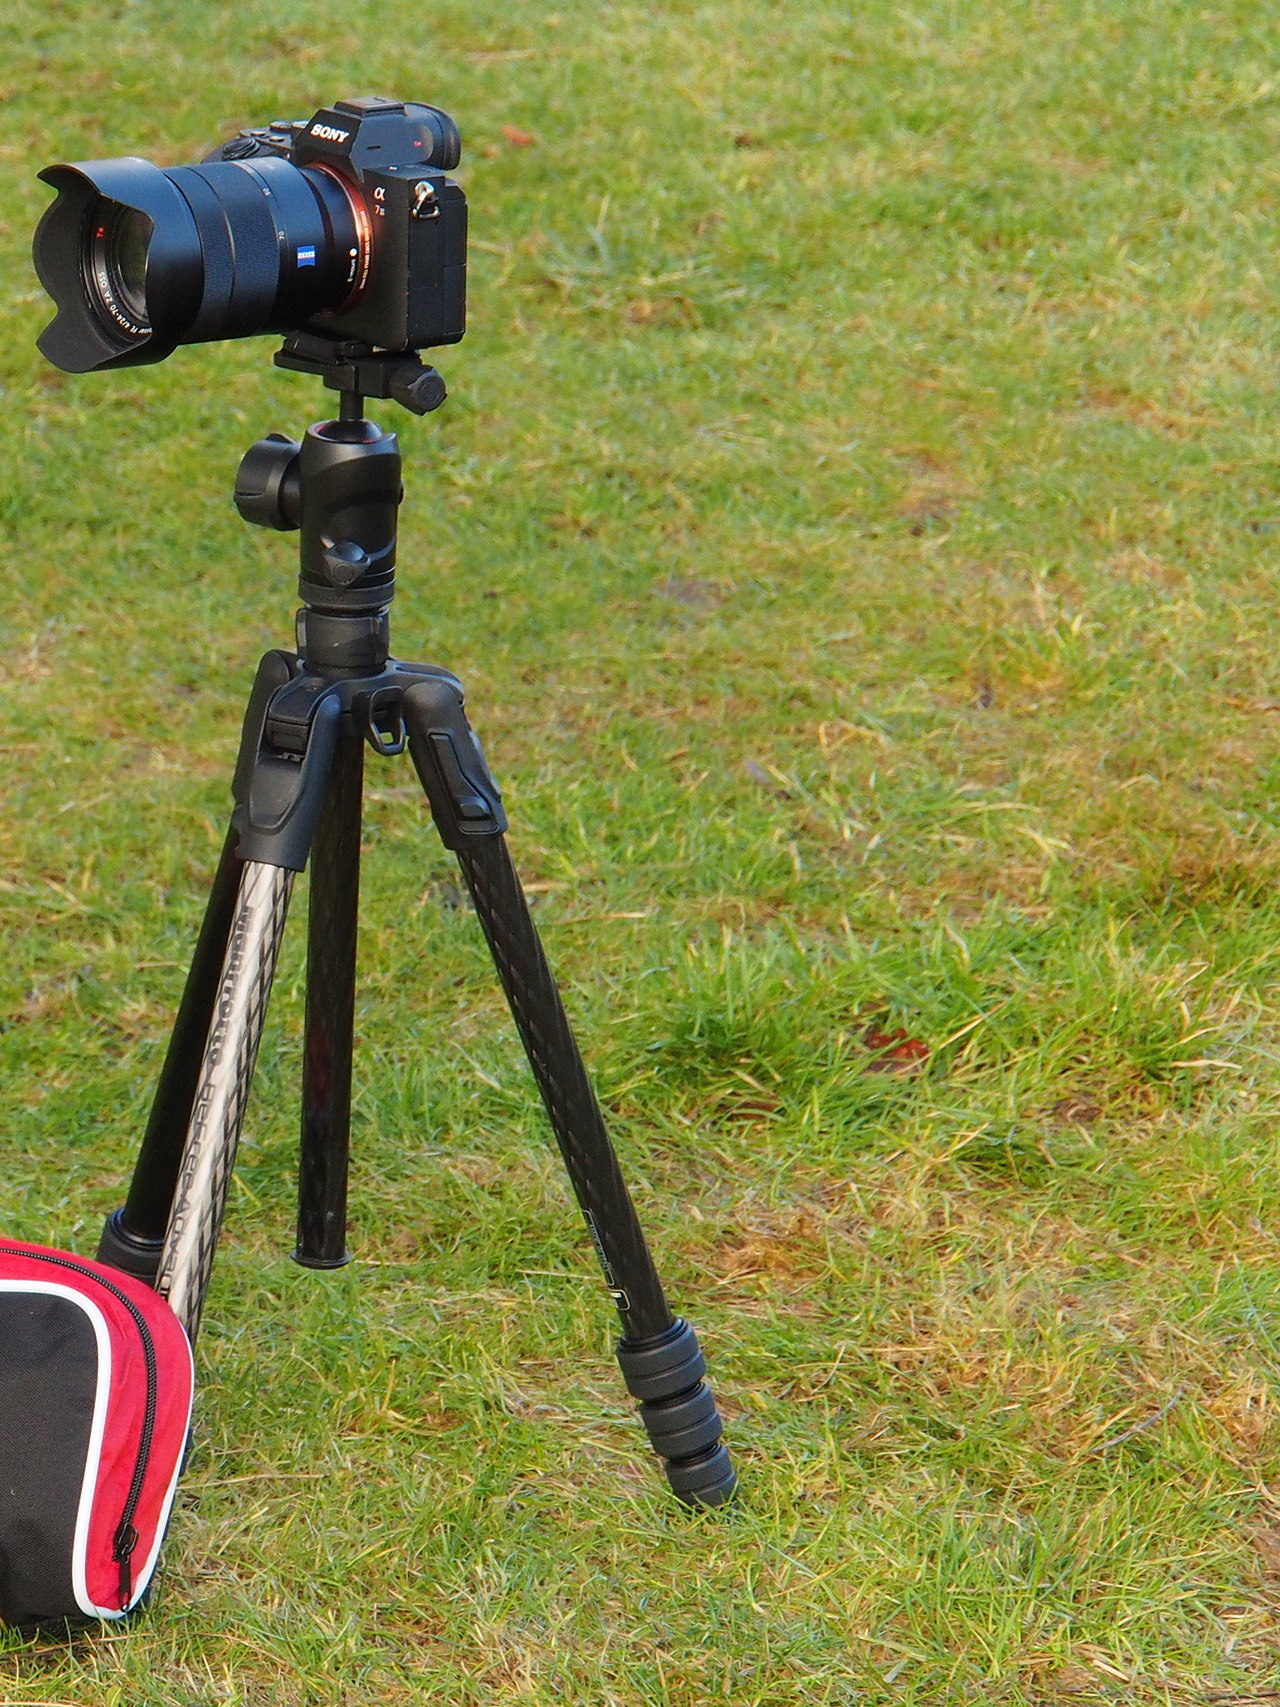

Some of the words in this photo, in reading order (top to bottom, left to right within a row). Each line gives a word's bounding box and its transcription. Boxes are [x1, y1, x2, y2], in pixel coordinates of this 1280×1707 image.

[310, 123, 350, 143] SONY
[374, 186, 386, 201] α
[98, 271, 108, 288] OSS
[103, 291, 113, 303] ZA
